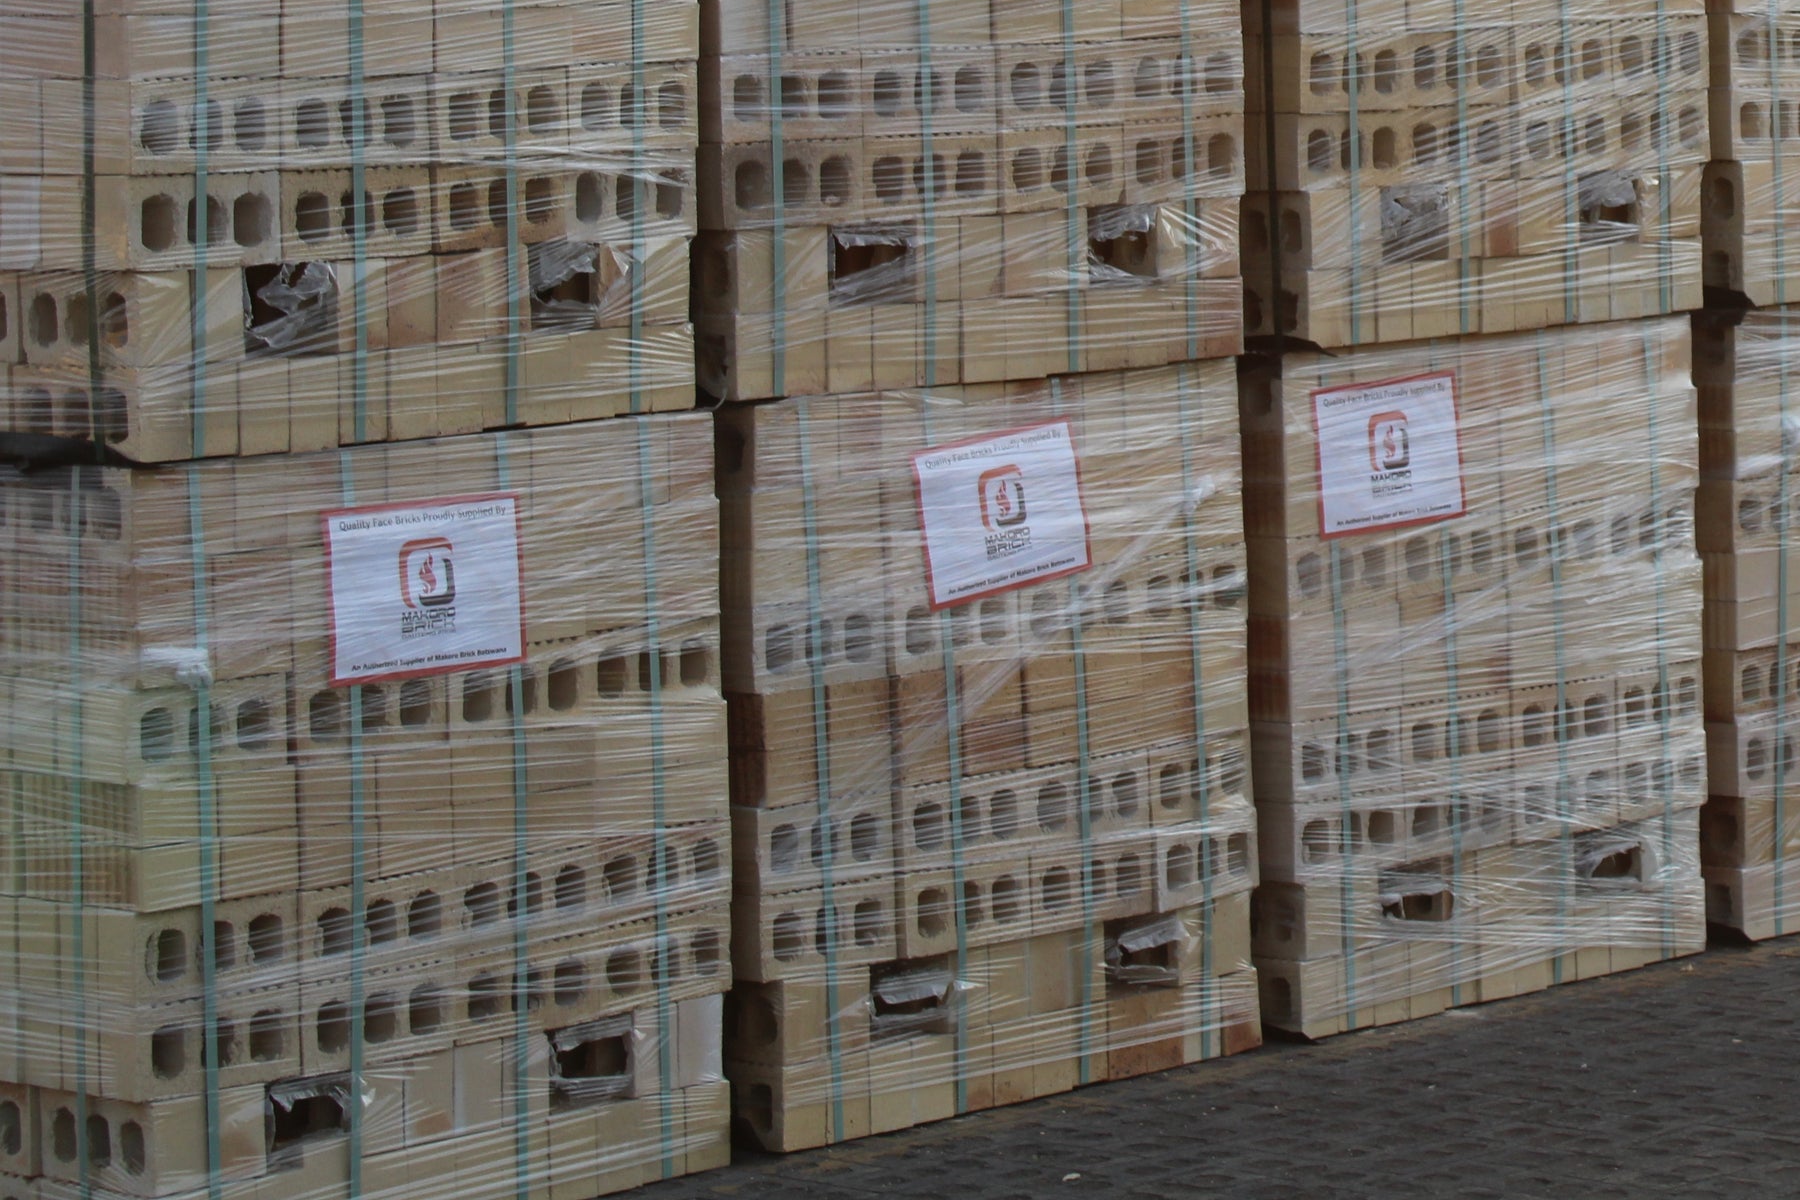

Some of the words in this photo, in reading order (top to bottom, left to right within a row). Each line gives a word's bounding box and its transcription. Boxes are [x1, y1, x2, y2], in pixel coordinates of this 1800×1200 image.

[1323, 397, 1346, 408] Quality
[1363, 392, 1383, 402] Bricks
[1383, 388, 1408, 400] Proudly
[924, 455, 951, 470] Quality
[952, 452, 969, 463] Face
[1370, 469, 1412, 481] MAKORO
[339, 519, 370, 532] Quality
[372, 517, 392, 528] Face
[395, 514, 421, 526] Bricks
[423, 511, 454, 524] Proudly
[458, 507, 493, 520] Supplied
[495, 505, 506, 517] By
[984, 526, 1030, 545] MAKORO
[986, 538, 1032, 555] BRICK
[988, 574, 1009, 585] Supplier
[1016, 567, 1036, 577] Makoro
[1037, 562, 1049, 571] Brick
[1050, 557, 1075, 568] Botswana
[402, 606, 456, 622] MAKORO
[402, 617, 456, 634] BRICK
[399, 656, 425, 666] Supplier
[434, 653, 458, 661] Makoro
[460, 650, 475, 658] Brick
[477, 647, 507, 657] Botswana
